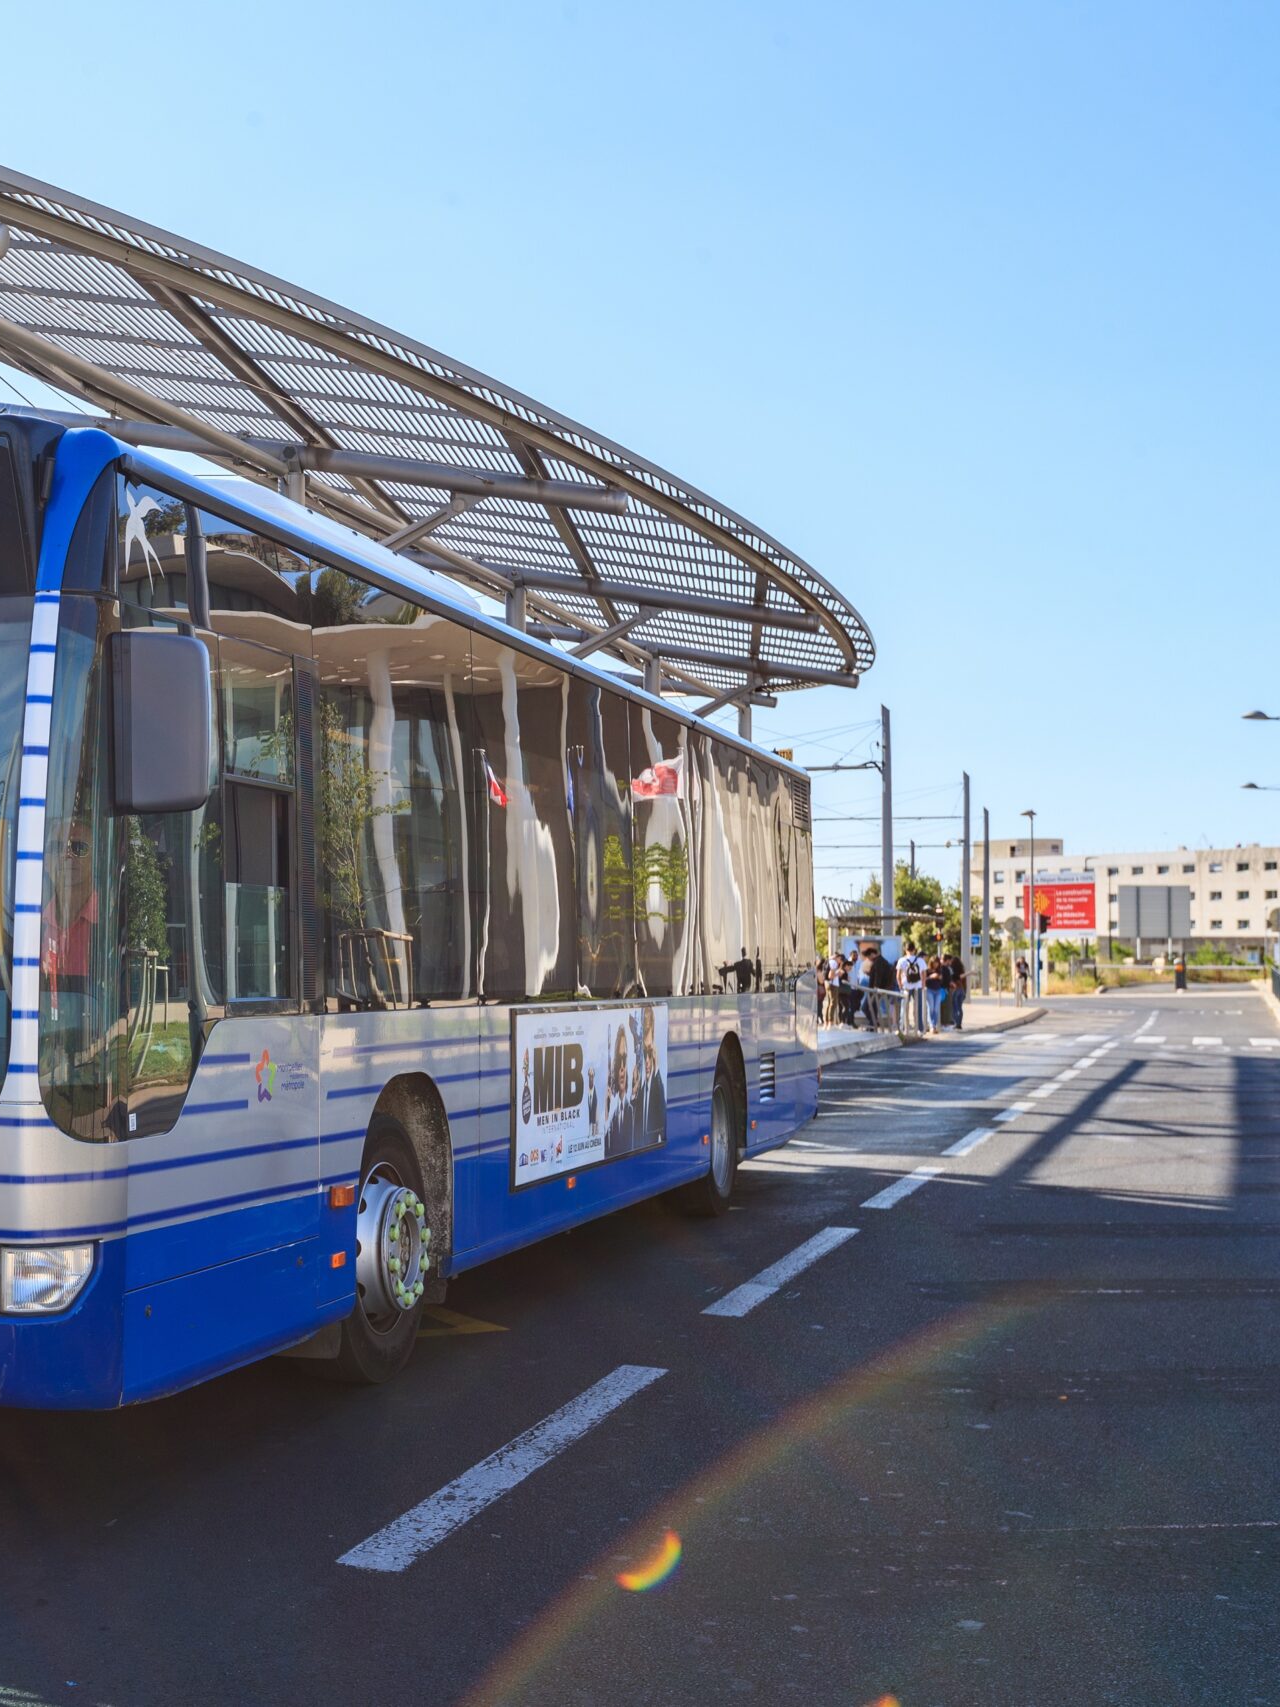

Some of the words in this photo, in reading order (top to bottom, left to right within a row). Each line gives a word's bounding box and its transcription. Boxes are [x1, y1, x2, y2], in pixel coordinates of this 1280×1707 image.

[534, 1043, 584, 1115] MIB
[536, 1115, 549, 1126] MEN
[552, 1113, 558, 1123] IN
[560, 1109, 580, 1121] BLACK
